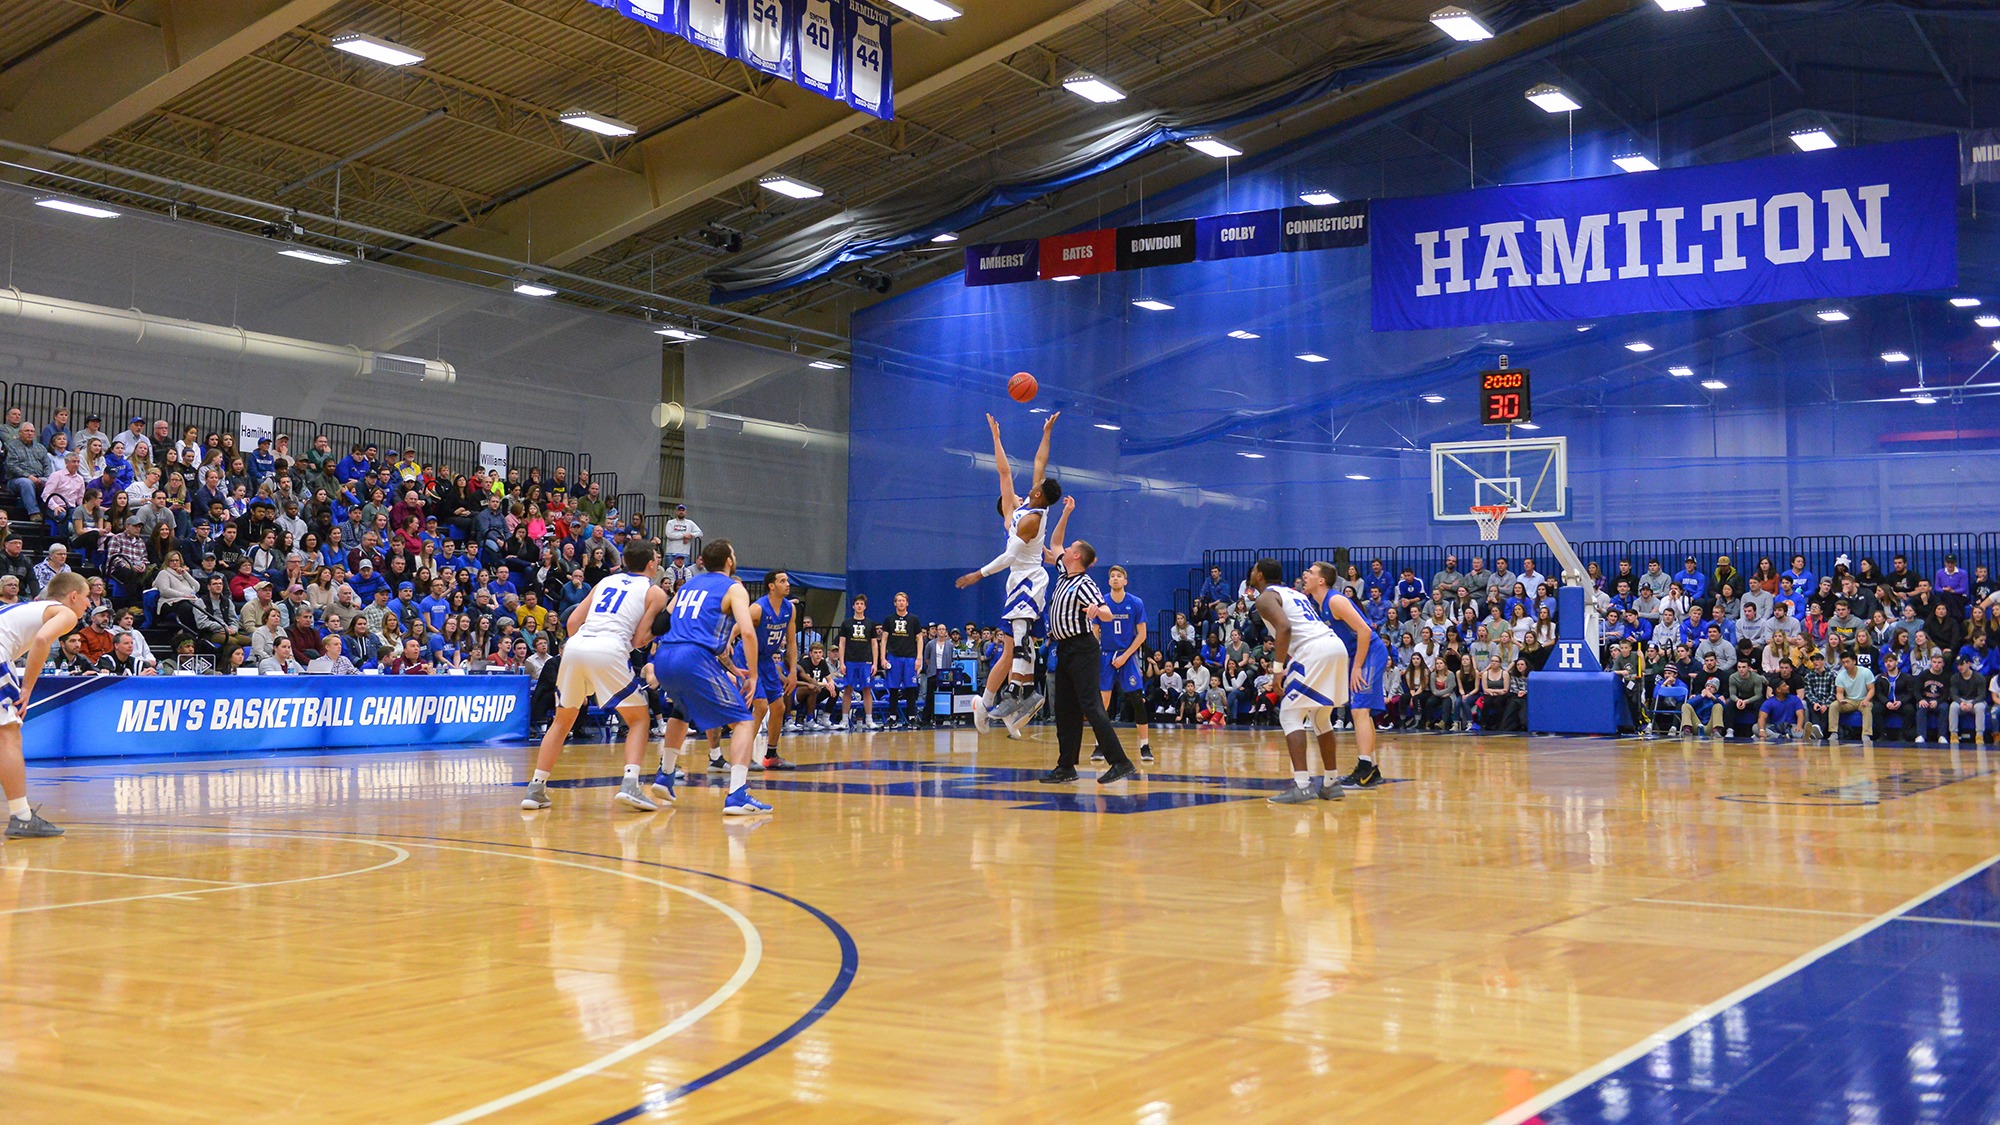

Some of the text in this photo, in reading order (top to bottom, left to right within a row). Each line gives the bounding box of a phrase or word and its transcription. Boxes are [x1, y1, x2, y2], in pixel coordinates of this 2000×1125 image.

[753, 0, 778, 28] 54
[809, 12, 828, 26] SMITH
[849, 1, 889, 26] HAMILTON
[806, 22, 829, 50] 40
[856, 44, 879, 72] 44
[1972, 144, 2000, 162] MID
[1285, 214, 1365, 235] CONNECTICUT
[1220, 225, 1256, 243] COLBY
[1415, 183, 1890, 297] HAMILTON
[1131, 234, 1182, 253] BOWDOIN
[979, 253, 1025, 270] AMHERST
[1062, 245, 1094, 261] BATES
[1483, 373, 1522, 389] 20:00
[1490, 394, 1519, 419] 30
[241, 424, 272, 439] Hamilton
[481, 453, 507, 467] Williams
[595, 587, 628, 614] 31
[675, 589, 709, 619] 44
[852, 624, 866, 638] H
[895, 620, 907, 633] H
[1114, 620, 1122, 634] 0
[767, 630, 783, 645] 24
[1559, 643, 1583, 668] H
[1858, 655, 1871, 665] 66
[116, 694, 517, 733] MEN'S BASKETBALL CHAMPIONSHIP
